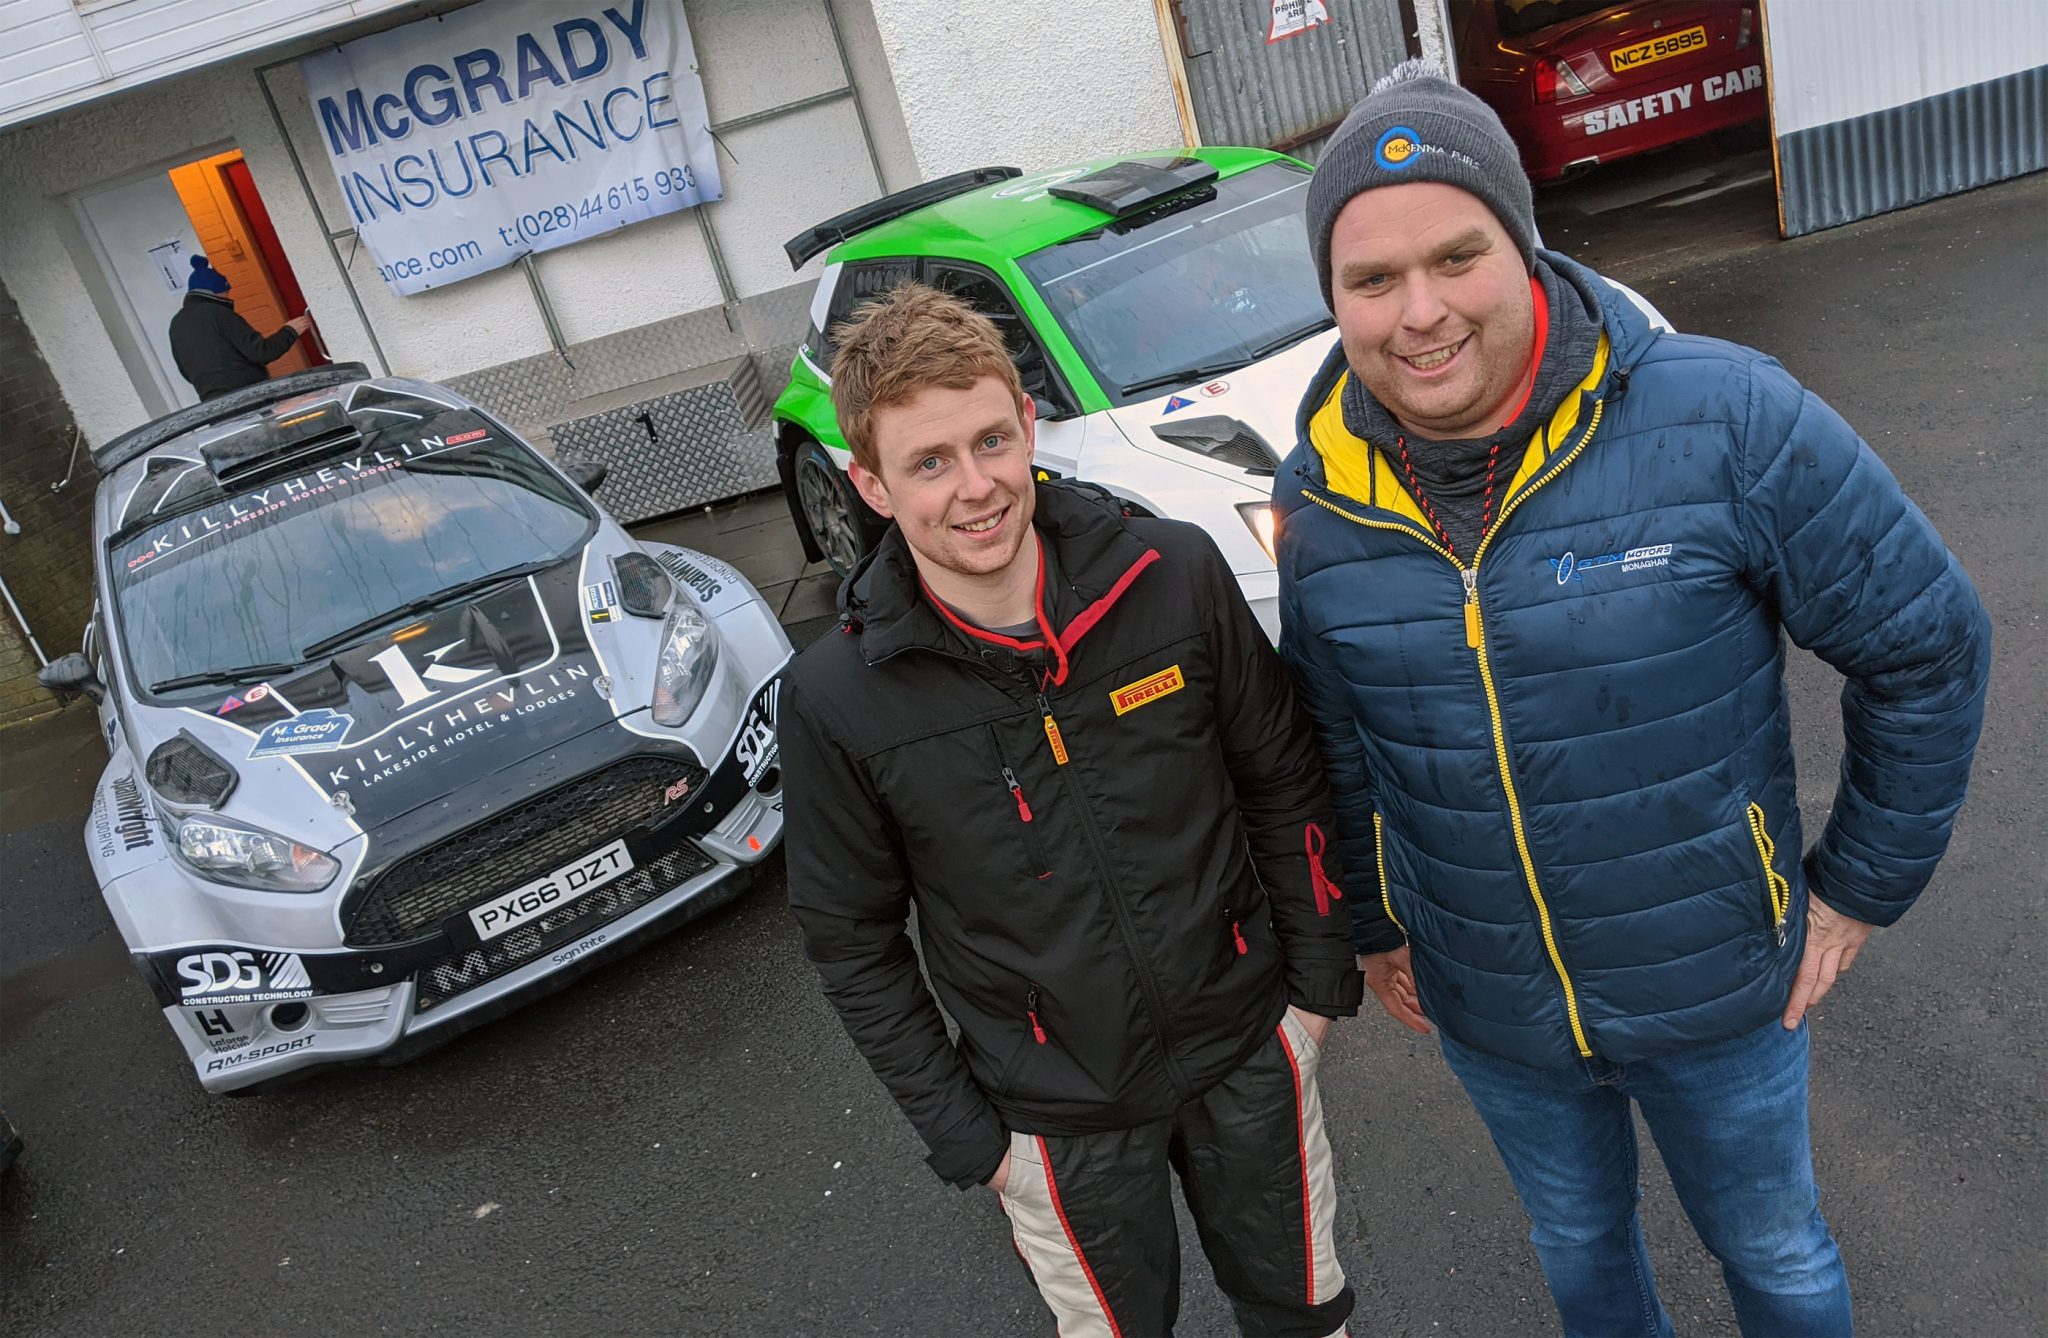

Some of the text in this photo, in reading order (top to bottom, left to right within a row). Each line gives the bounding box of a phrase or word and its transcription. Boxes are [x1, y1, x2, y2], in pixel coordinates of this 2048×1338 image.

[1614, 31, 1704, 68] NCZ 5895
[317, 0, 650, 157] McGRADY
[1583, 64, 1763, 136] SAFETY CAR
[341, 71, 680, 224] INSURANCE
[608, 177, 650, 210] 615
[654, 164, 697, 196] 933
[1205, 382, 1225, 395] E
[153, 435, 446, 553] KILLYHEVLIN
[224, 500, 286, 530] LAKESIDE
[292, 483, 334, 504] HOTEL
[351, 461, 402, 482] LODGES
[1621, 557, 1669, 573] MONAGHAN
[1626, 546, 1671, 560] MOTORS
[1115, 671, 1178, 709] PIRELLI
[271, 721, 340, 738] McGrady
[275, 733, 324, 744] Insurance
[329, 664, 589, 786] KILLYHEVLIN
[363, 744, 438, 788] LAKESIDE
[444, 721, 494, 747] HOTEL
[515, 689, 576, 716] LODGES
[95, 814, 116, 858] FLOORING
[478, 847, 621, 931] PX66 DZT
[552, 933, 608, 966] Sign Rite
[177, 951, 261, 996] SDG
[183, 989, 314, 1006] CONSTRUCTION TECHNOLOGY
[206, 1033, 317, 1074] RM-SPORT
